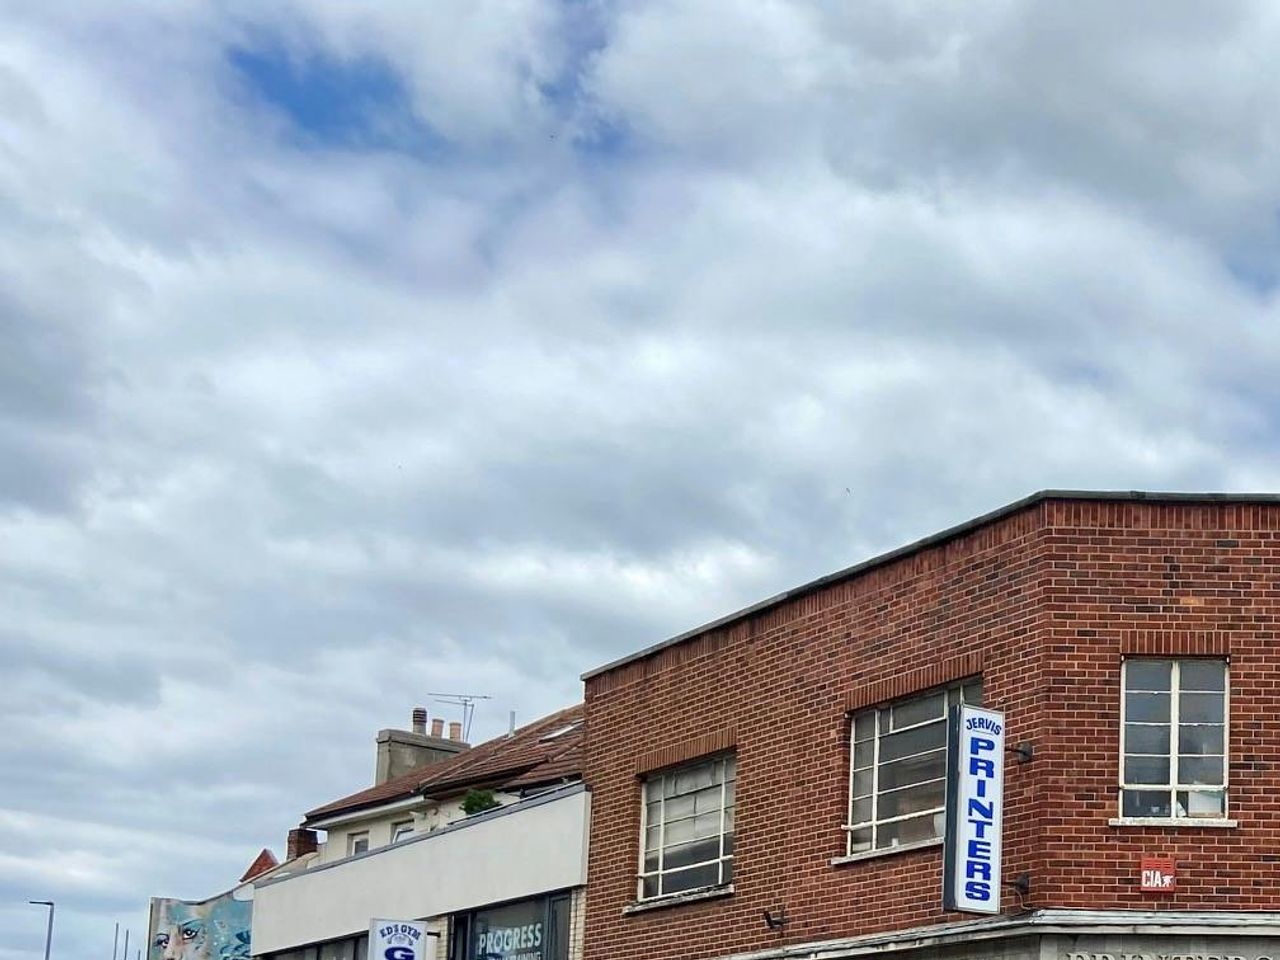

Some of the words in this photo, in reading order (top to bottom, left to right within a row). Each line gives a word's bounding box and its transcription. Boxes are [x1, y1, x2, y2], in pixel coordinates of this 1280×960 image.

[966, 717, 1002, 736] JERVIS
[965, 737, 995, 901] PRINTERS
[1142, 870, 1162, 888] CIA
[401, 925, 421, 940] GYM
[479, 923, 542, 954] PROGRESS
